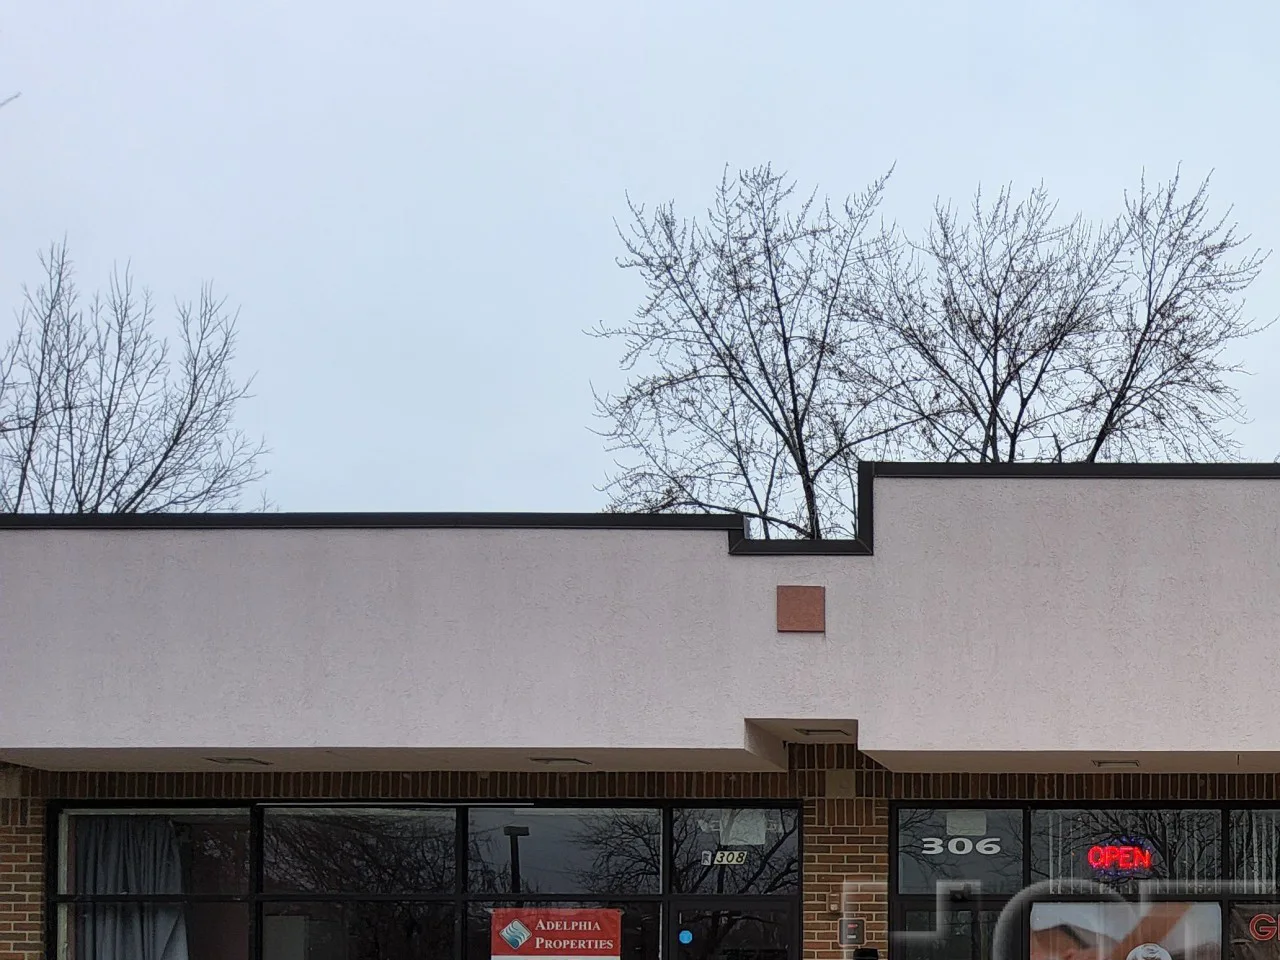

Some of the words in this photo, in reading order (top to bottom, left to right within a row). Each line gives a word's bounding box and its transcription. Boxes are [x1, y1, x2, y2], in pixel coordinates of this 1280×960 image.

[922, 837, 1001, 855] 306
[716, 851, 746, 864] 308
[1088, 845, 1151, 868] OPEN
[535, 919, 601, 931] ADELPHIA
[535, 937, 614, 949] PROPERTIES
